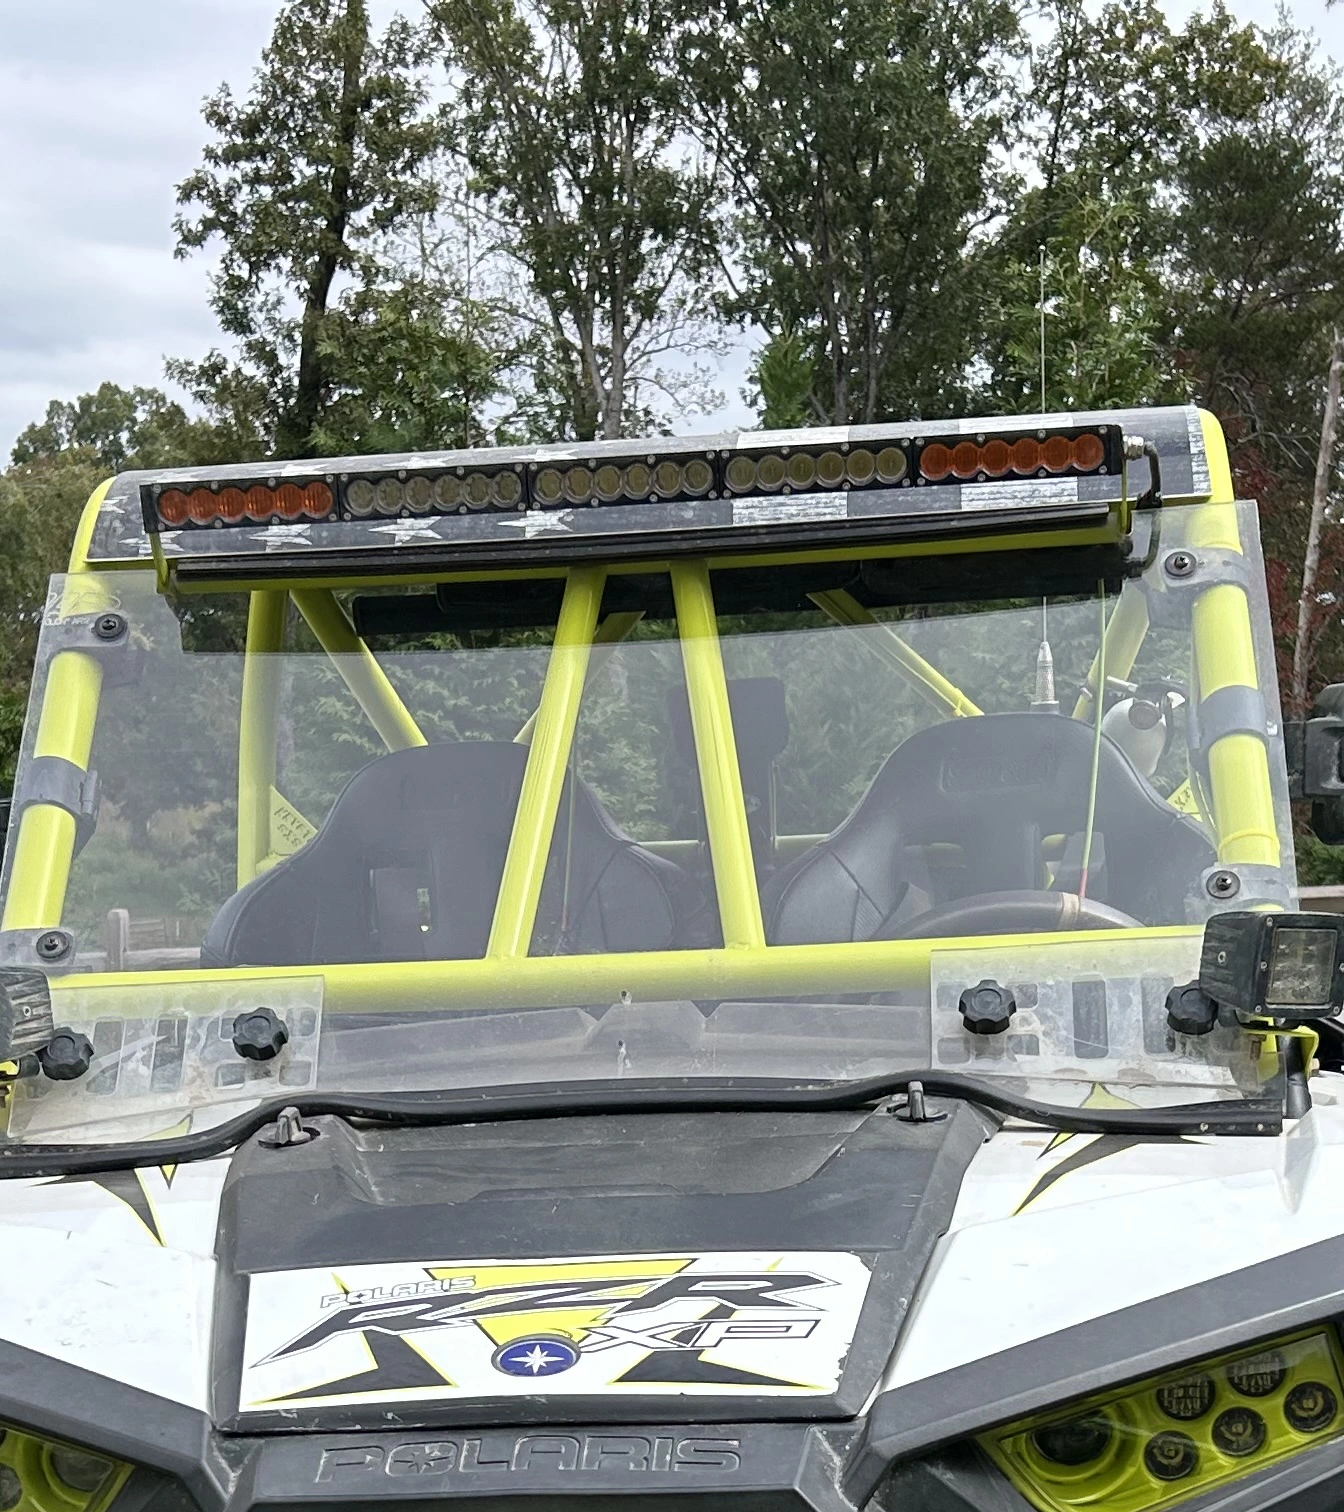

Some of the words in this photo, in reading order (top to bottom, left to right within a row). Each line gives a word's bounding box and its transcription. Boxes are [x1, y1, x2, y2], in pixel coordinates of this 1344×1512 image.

[320, 1275, 476, 1308] POLARIS
[249, 1271, 841, 1368] RZR
[578, 1318, 821, 1353] XP
[314, 1434, 743, 1483] POLARIS
